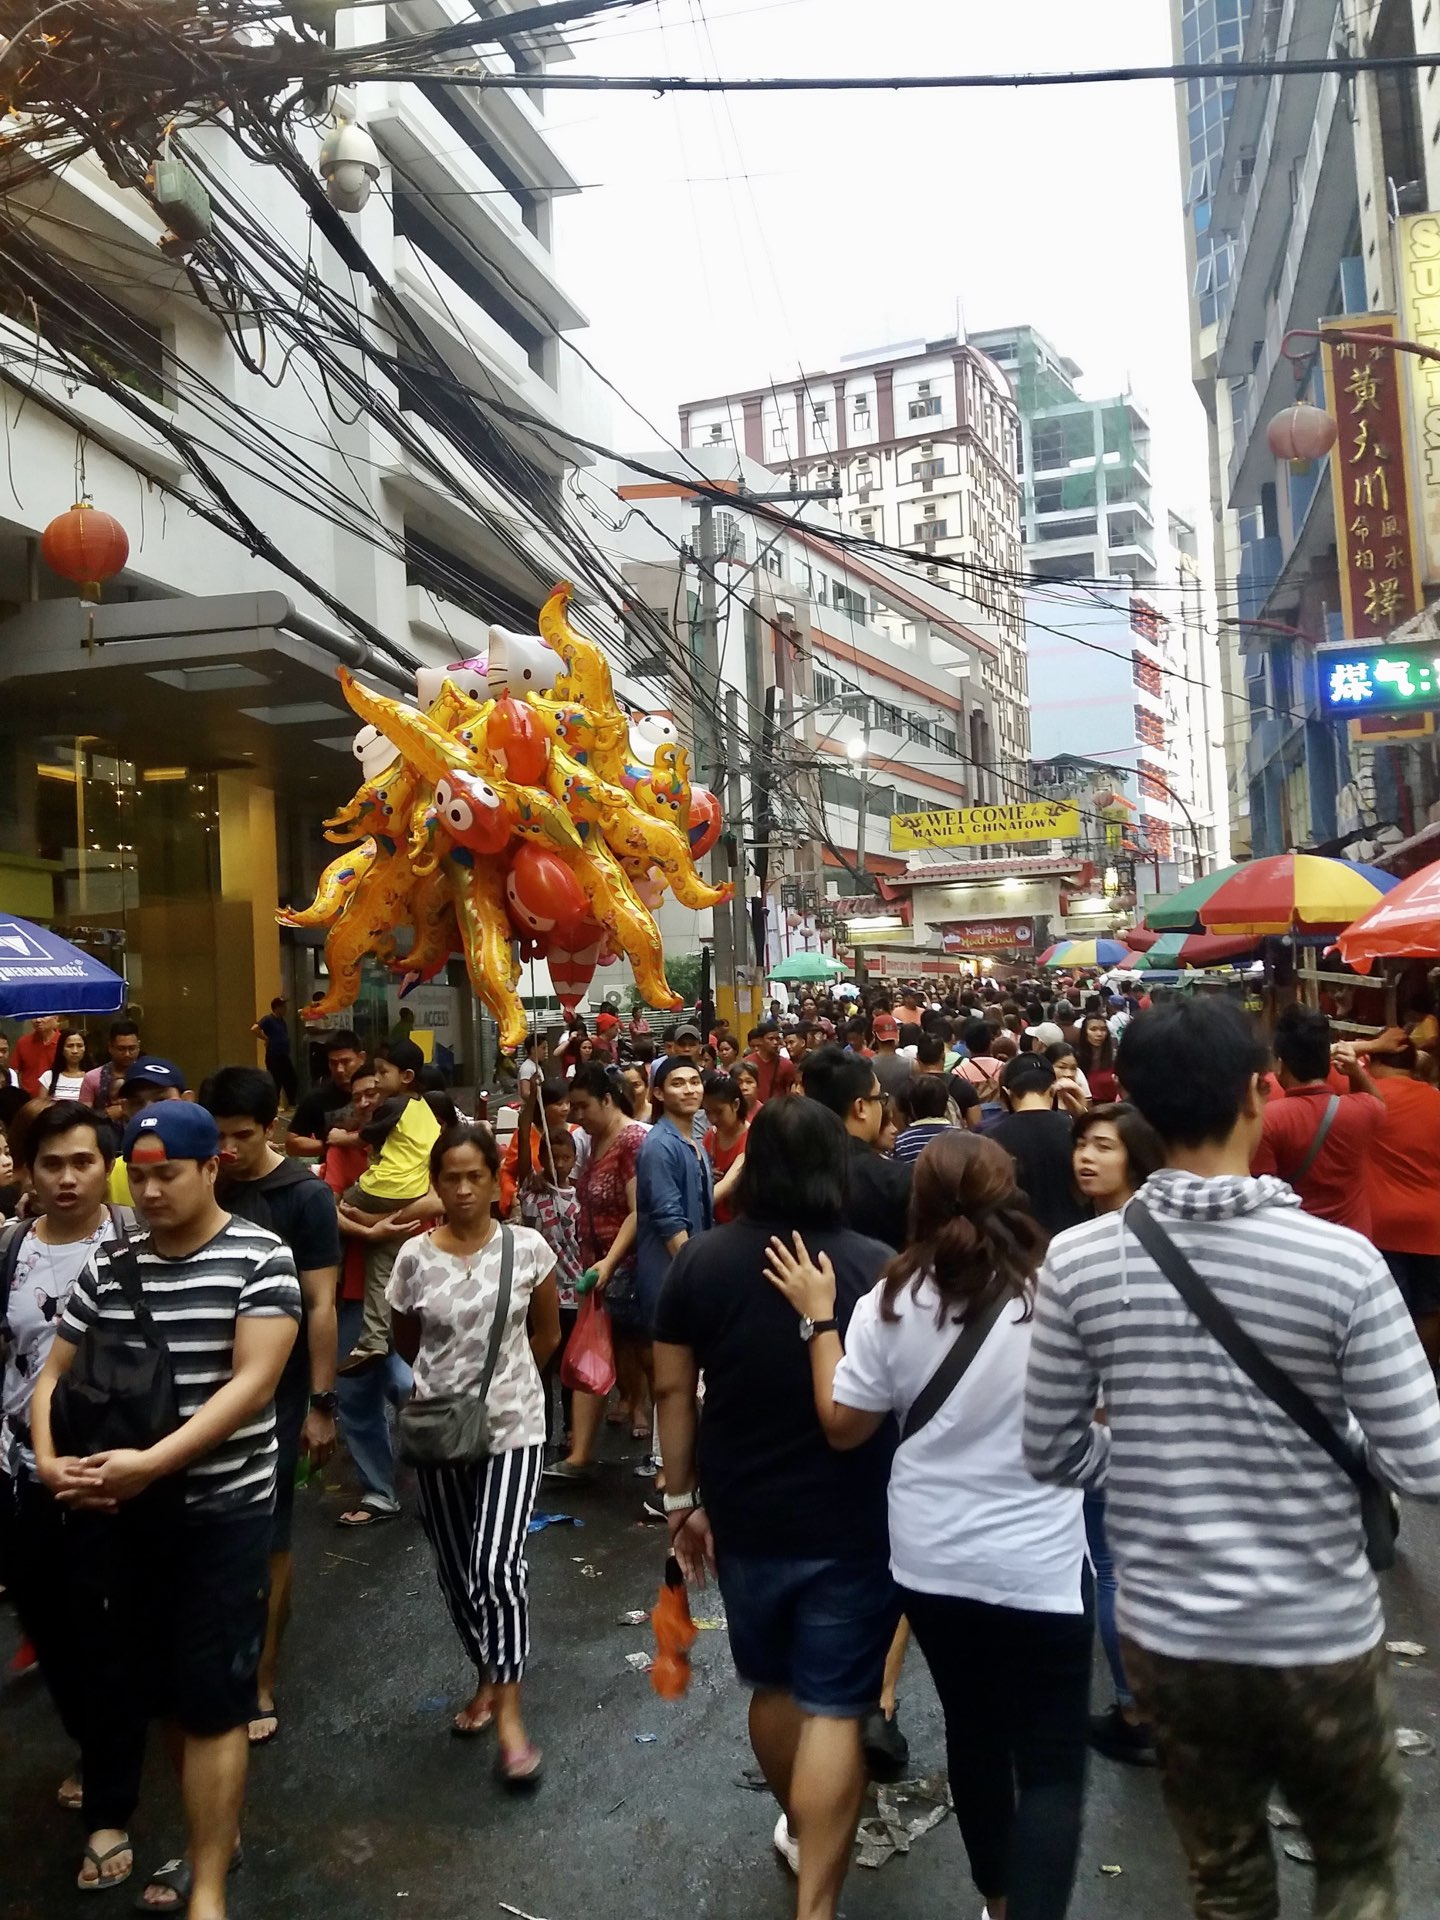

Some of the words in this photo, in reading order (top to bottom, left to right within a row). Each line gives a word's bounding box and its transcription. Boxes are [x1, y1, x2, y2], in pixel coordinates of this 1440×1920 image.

[926, 805, 1027, 827] WELCOME
[913, 825, 965, 838] MANILA
[972, 818, 1057, 834] CHINATOWN
